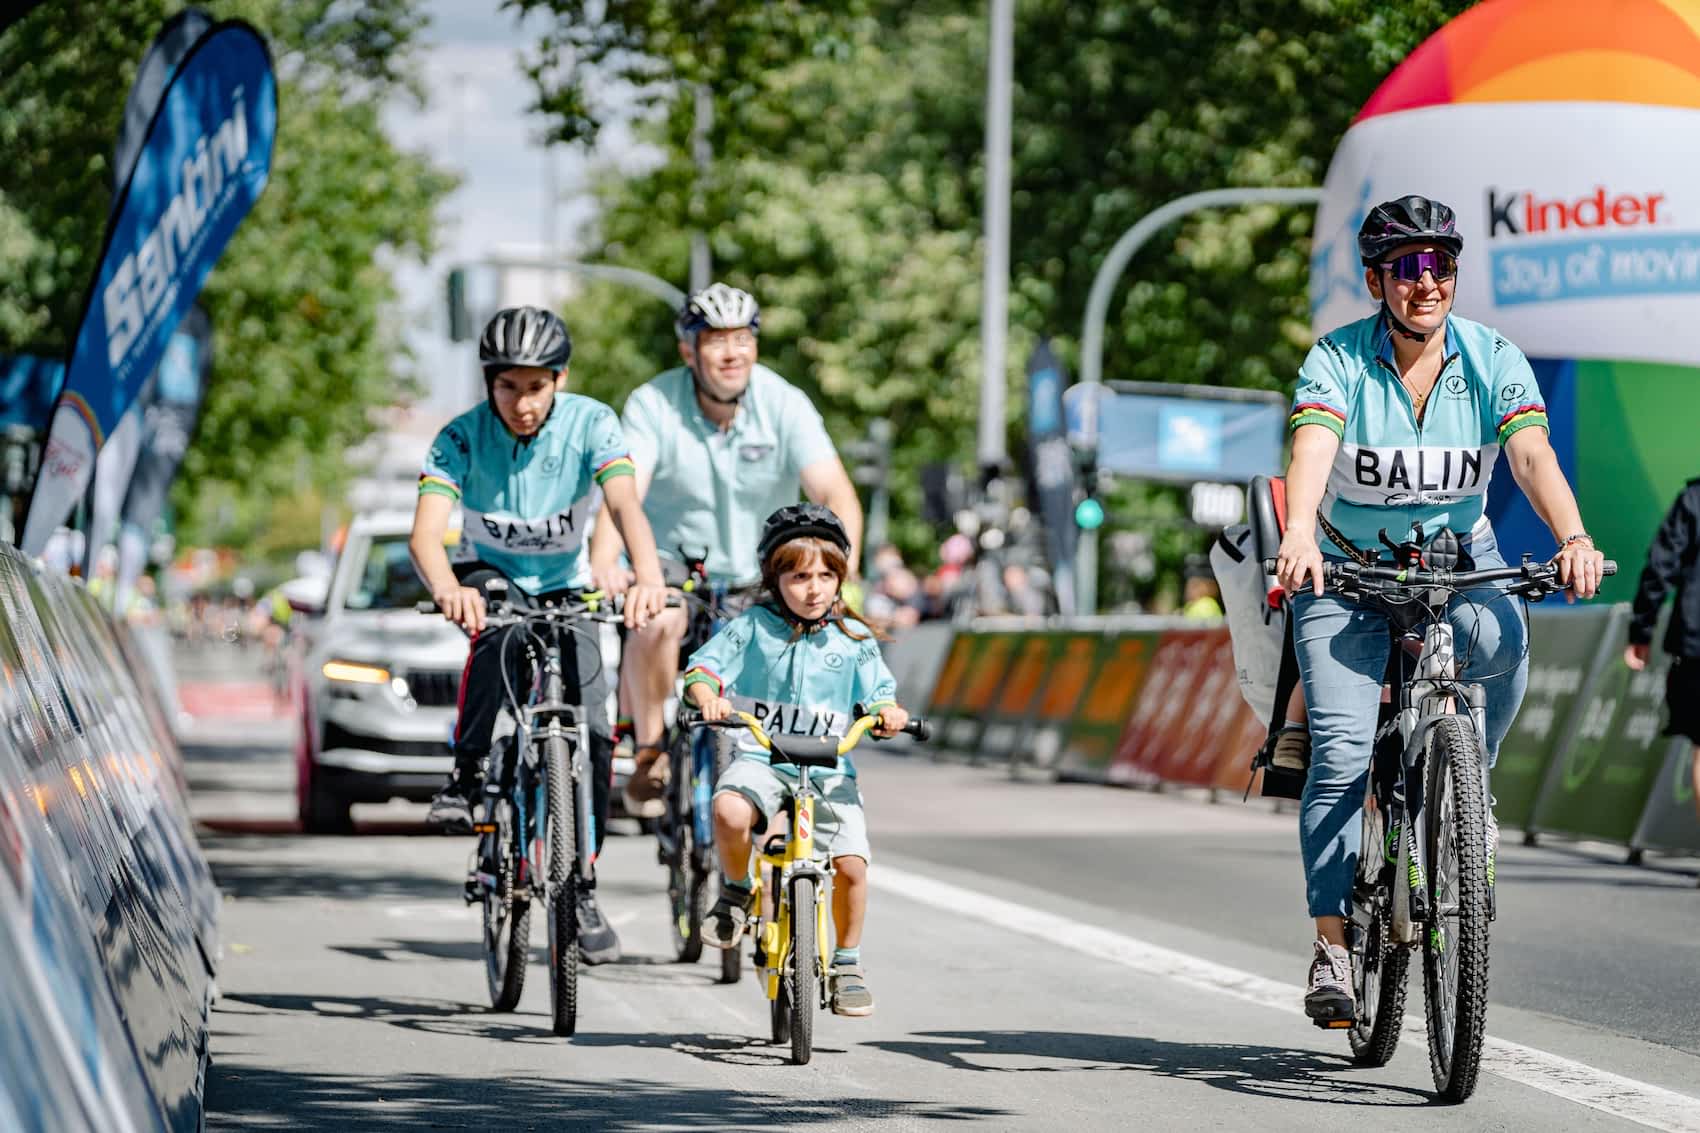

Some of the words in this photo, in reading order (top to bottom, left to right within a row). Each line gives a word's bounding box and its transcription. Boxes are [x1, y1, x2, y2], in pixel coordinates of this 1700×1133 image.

[1488, 184, 1665, 238] Kinder
[1499, 254, 1560, 296] Joy
[1565, 243, 1604, 287] of
[1354, 448, 1482, 492] BALIN
